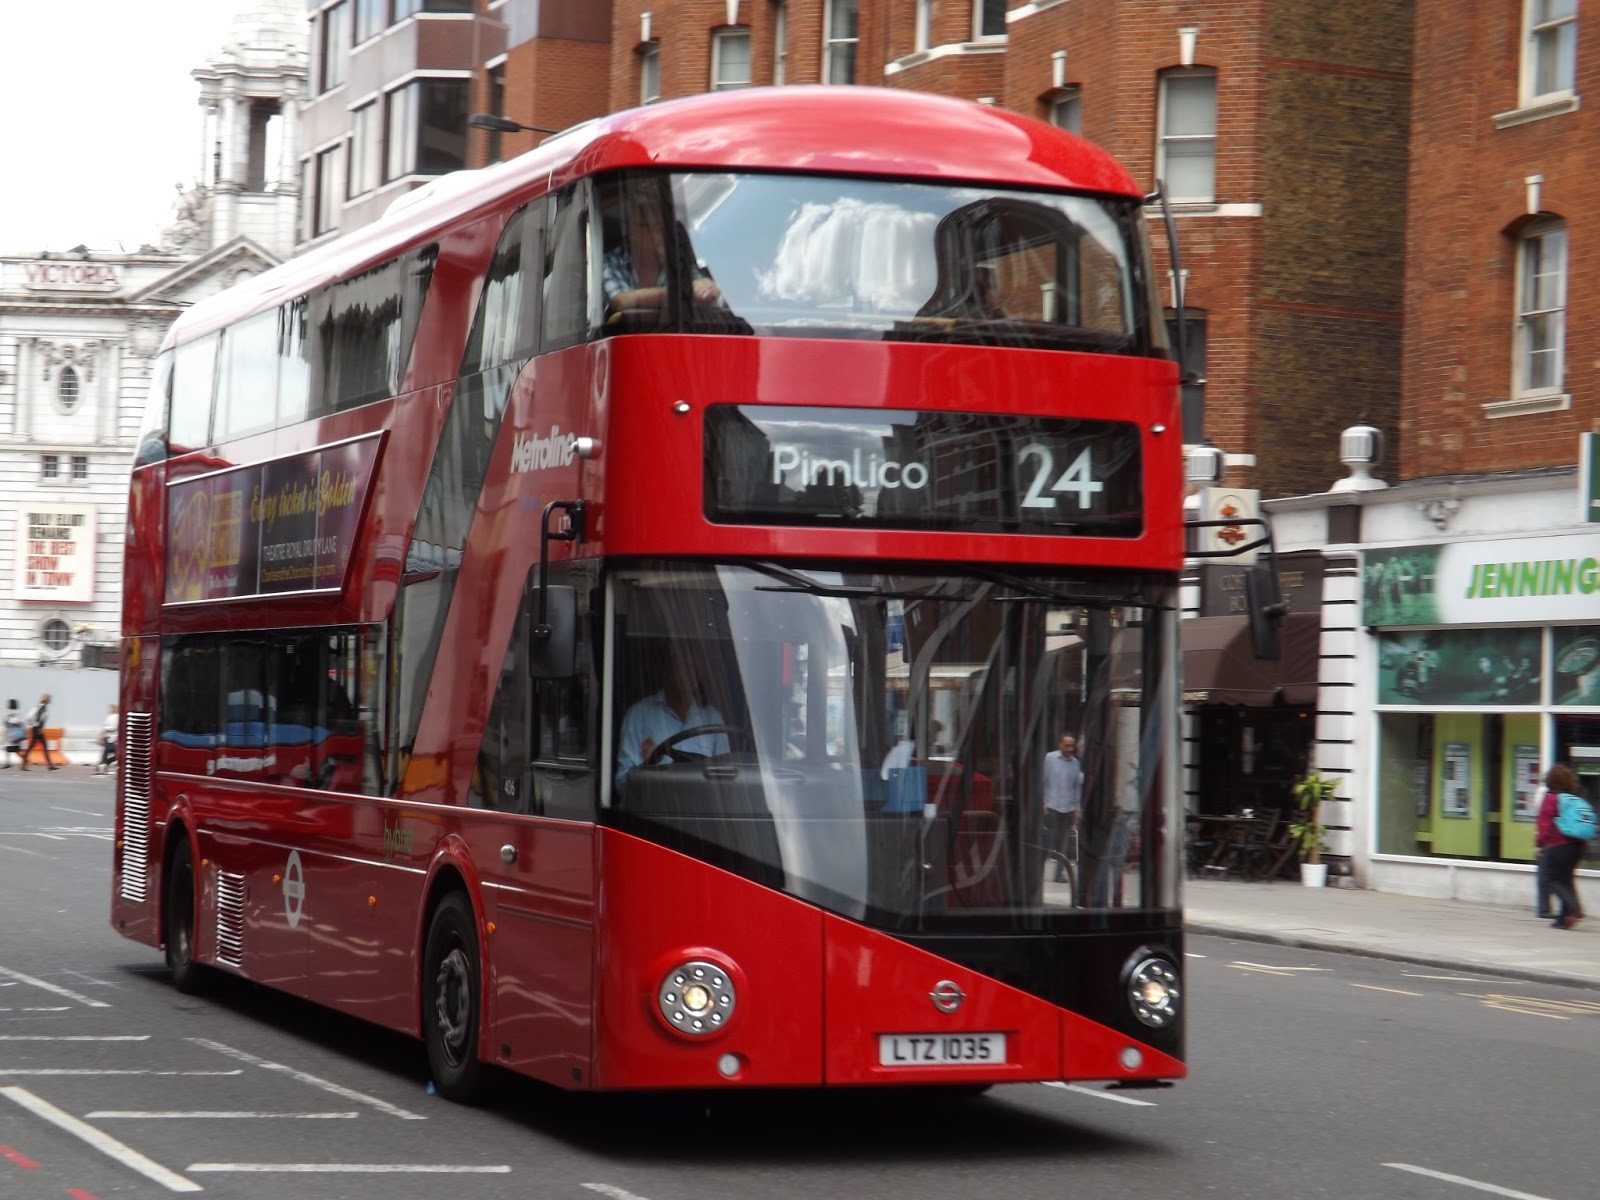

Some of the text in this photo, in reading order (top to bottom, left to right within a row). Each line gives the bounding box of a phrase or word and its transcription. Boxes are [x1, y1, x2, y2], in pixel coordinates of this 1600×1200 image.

[25, 264, 119, 284] VICTORIA
[510, 425, 576, 474] Metroline
[772, 443, 1103, 510] Pimlico 24
[1465, 557, 1600, 600] JENNING
[893, 1037, 990, 1061] LTZ 1035
